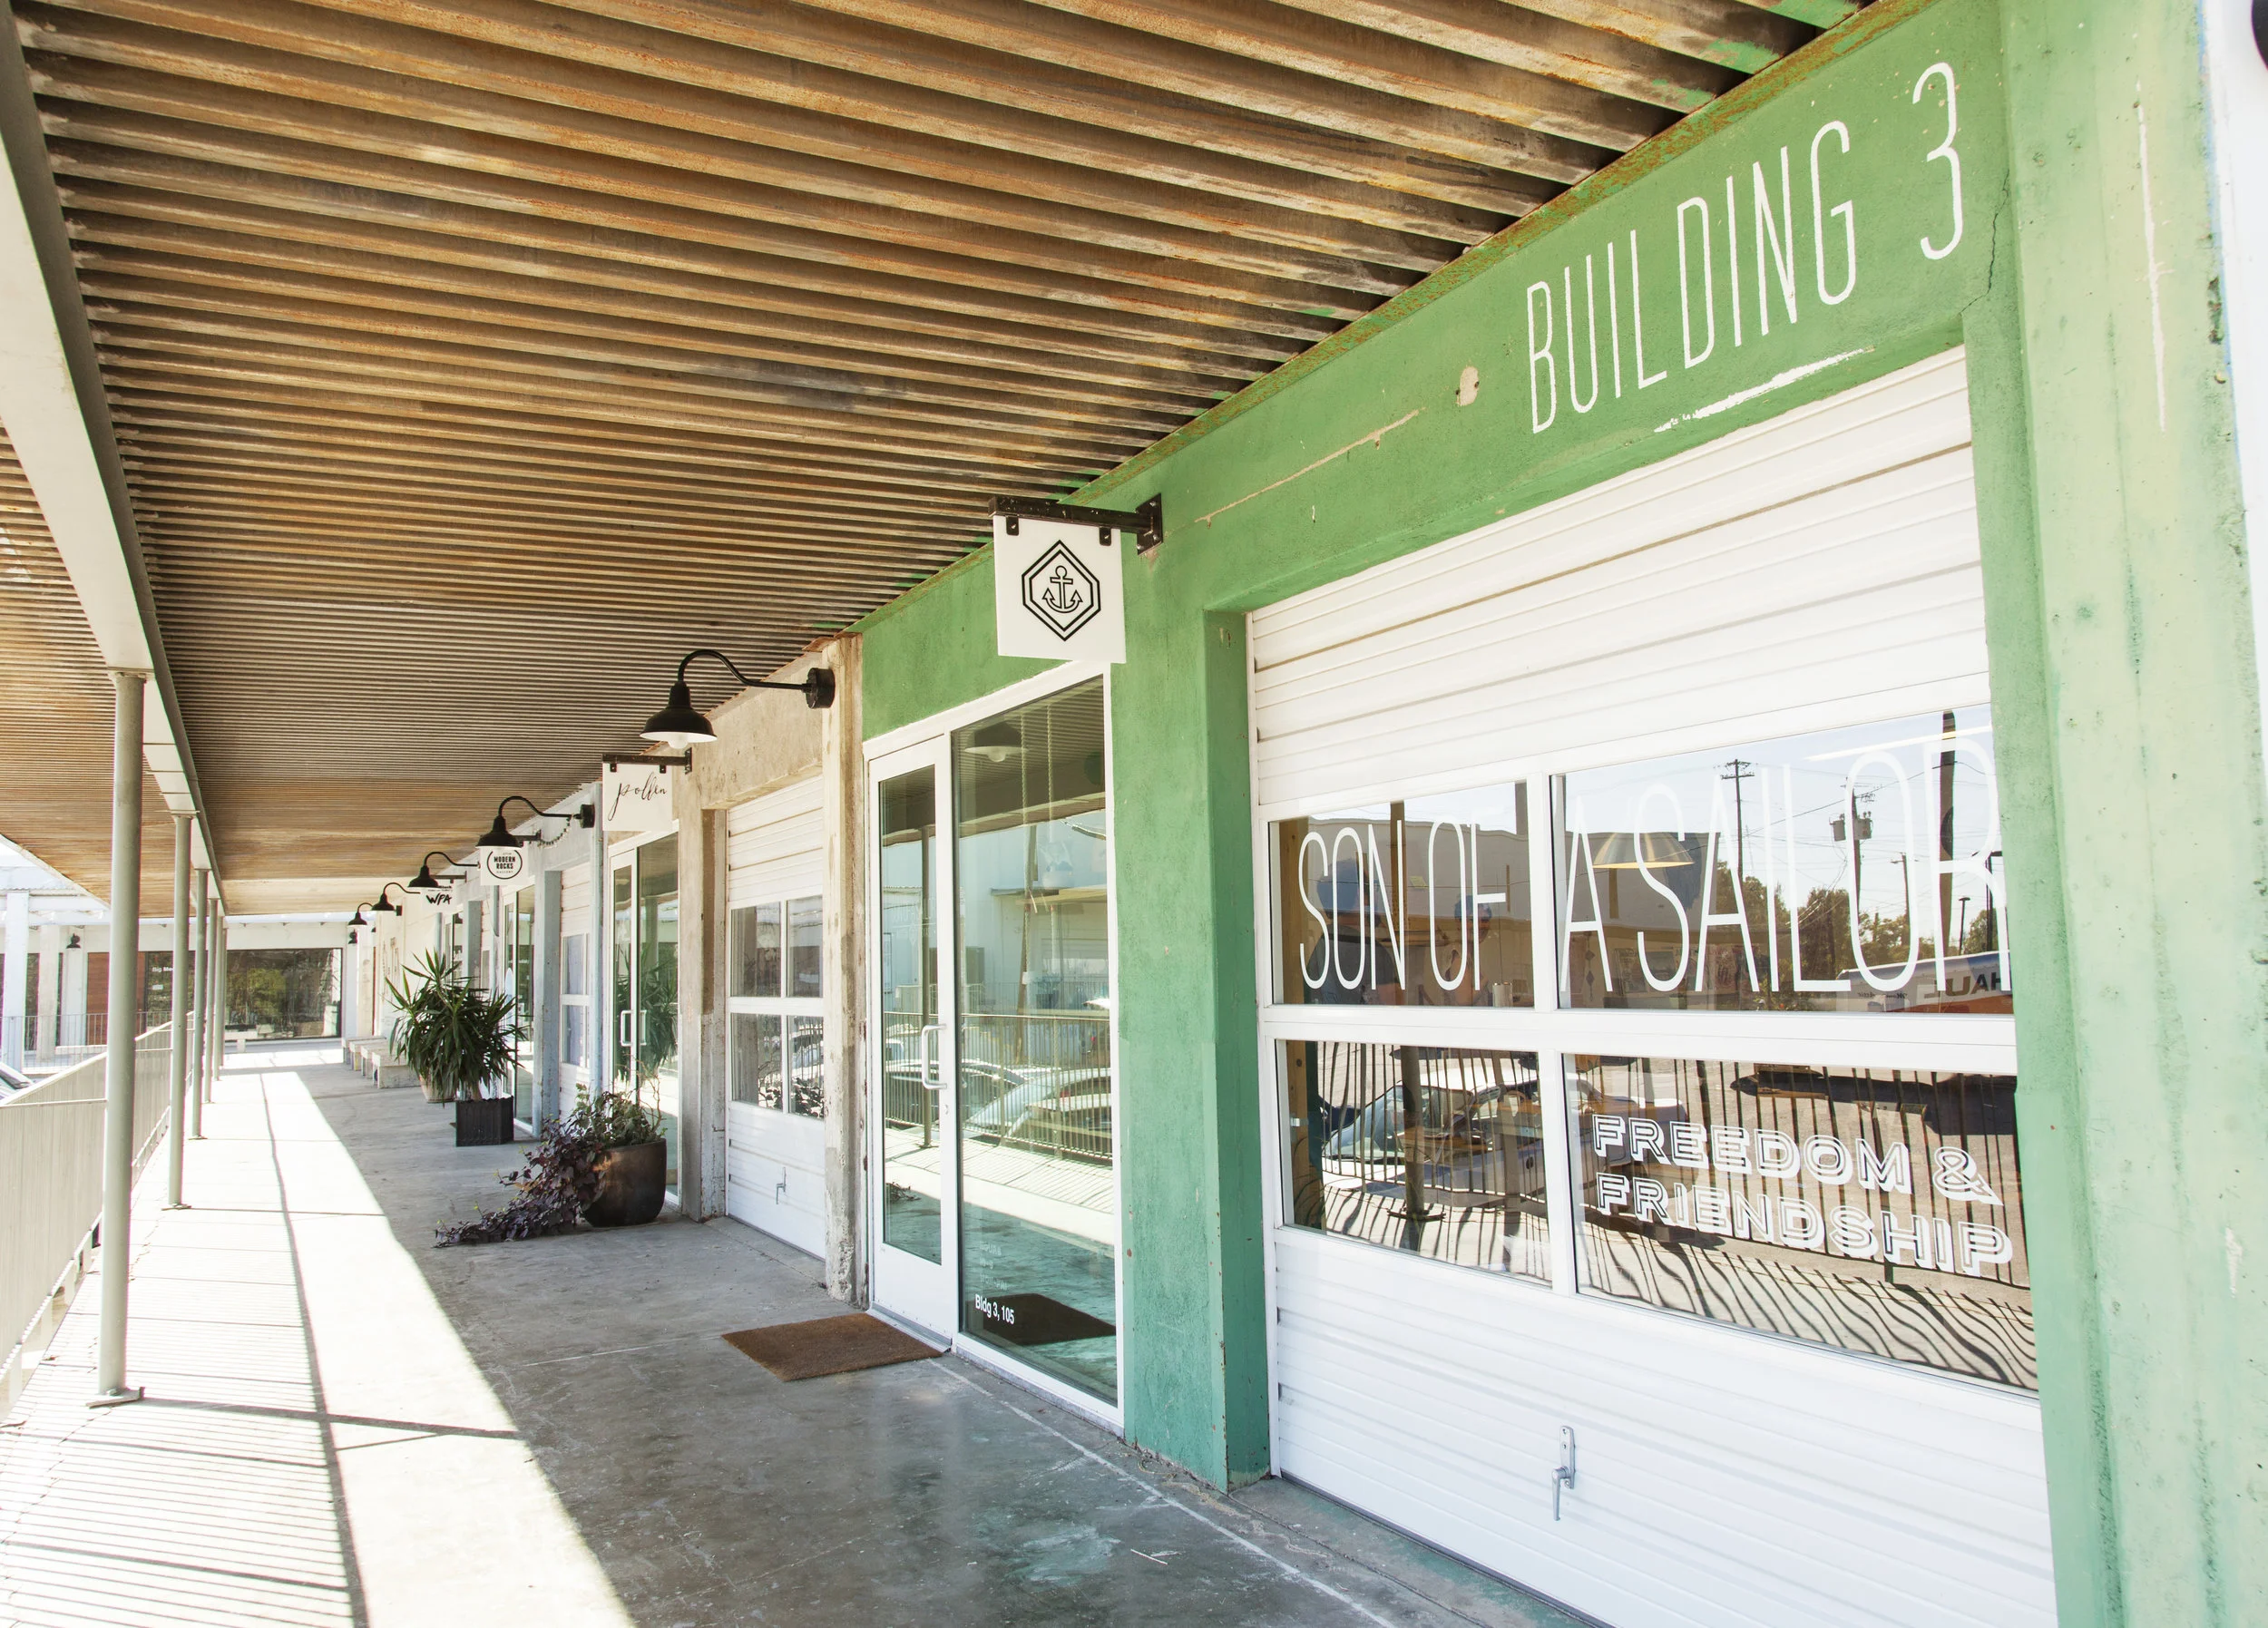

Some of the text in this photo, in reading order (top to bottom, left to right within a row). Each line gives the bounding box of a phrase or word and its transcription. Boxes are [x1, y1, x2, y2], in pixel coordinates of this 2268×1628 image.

[1526, 61, 1964, 434] BUILDING 3
[607, 771, 668, 822] pollen
[425, 892, 453, 906] WPA
[1298, 819, 1407, 991] SON
[1559, 795, 1614, 992] A
[1633, 736, 2012, 992] SAILOR
[1592, 1114, 2005, 1206] FREEDOM &
[1595, 1172, 2014, 1277] FRIENDSHIP
[975, 1294, 1015, 1325] Bldg 3, 105
